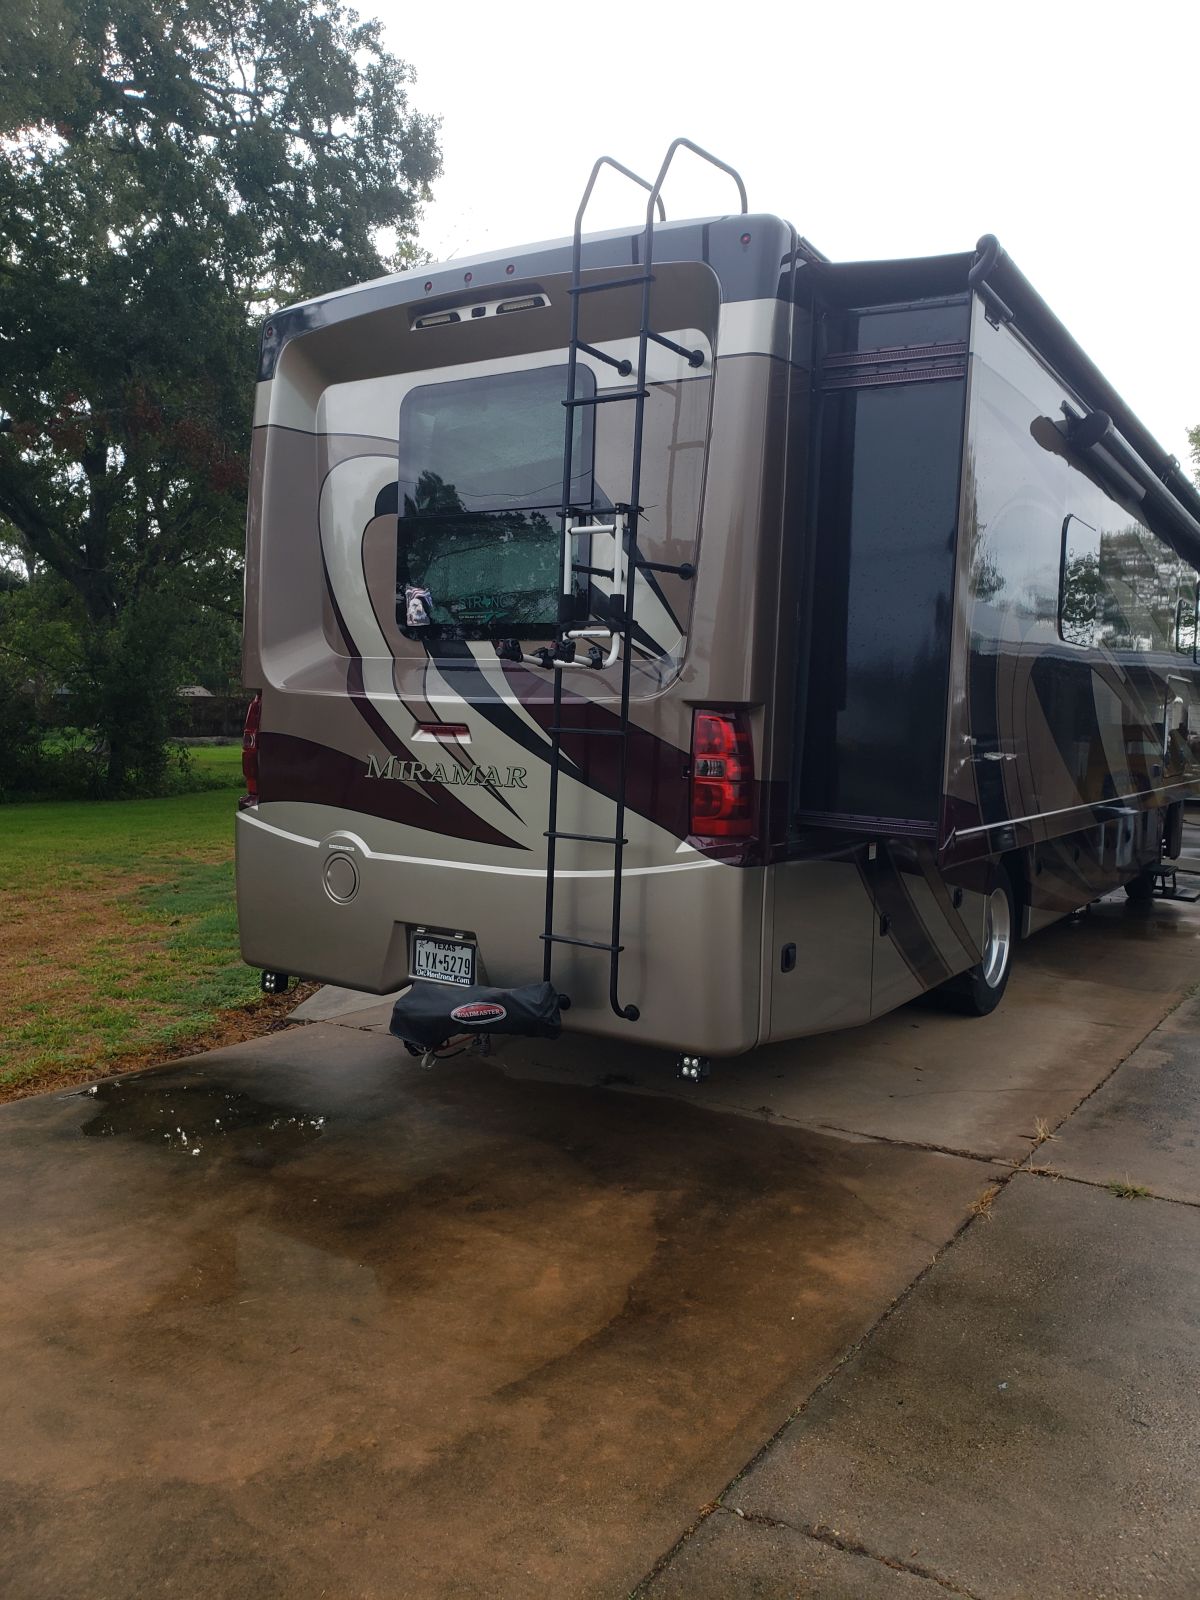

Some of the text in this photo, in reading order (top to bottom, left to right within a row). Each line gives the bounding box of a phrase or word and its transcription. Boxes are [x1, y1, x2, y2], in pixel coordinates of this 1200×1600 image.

[364, 754, 528, 789] MIRAMAR
[434, 943, 456, 953] TEXAS
[456, 1008, 501, 1019] ROADMASTER
